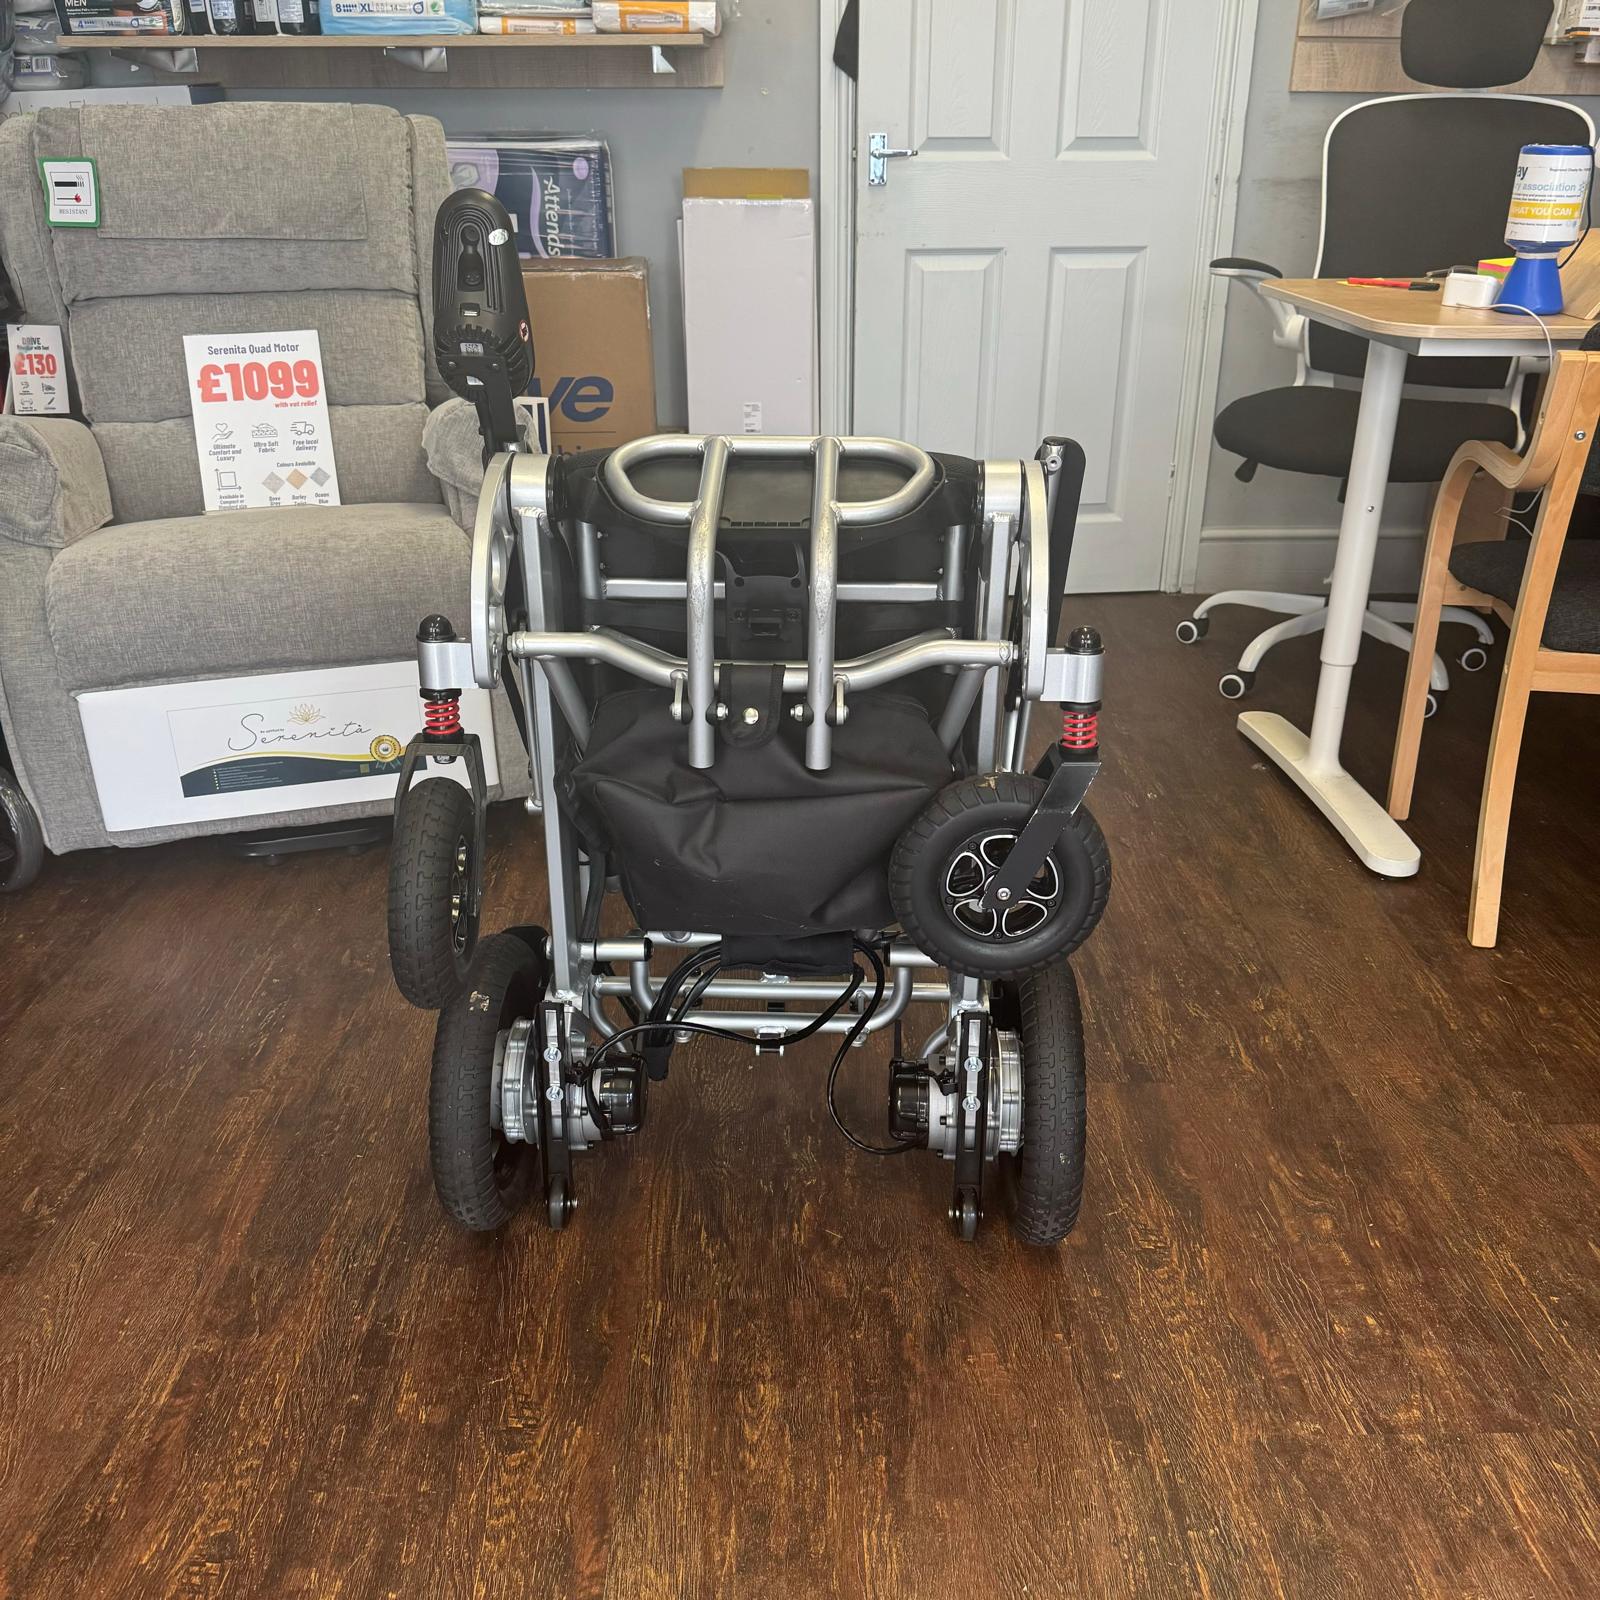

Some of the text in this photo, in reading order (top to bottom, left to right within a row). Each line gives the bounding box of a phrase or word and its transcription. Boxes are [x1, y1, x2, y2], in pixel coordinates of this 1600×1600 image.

[335, 3, 342, 13] 8
[360, 3, 374, 13] XL
[543, 175, 564, 256] Attends
[1531, 207, 1550, 216] YOU
[1553, 208, 1572, 216] CAN
[207, 343, 299, 355] Serenita Quad Motor
[14, 353, 57, 375] £130
[197, 360, 319, 402] £1099
